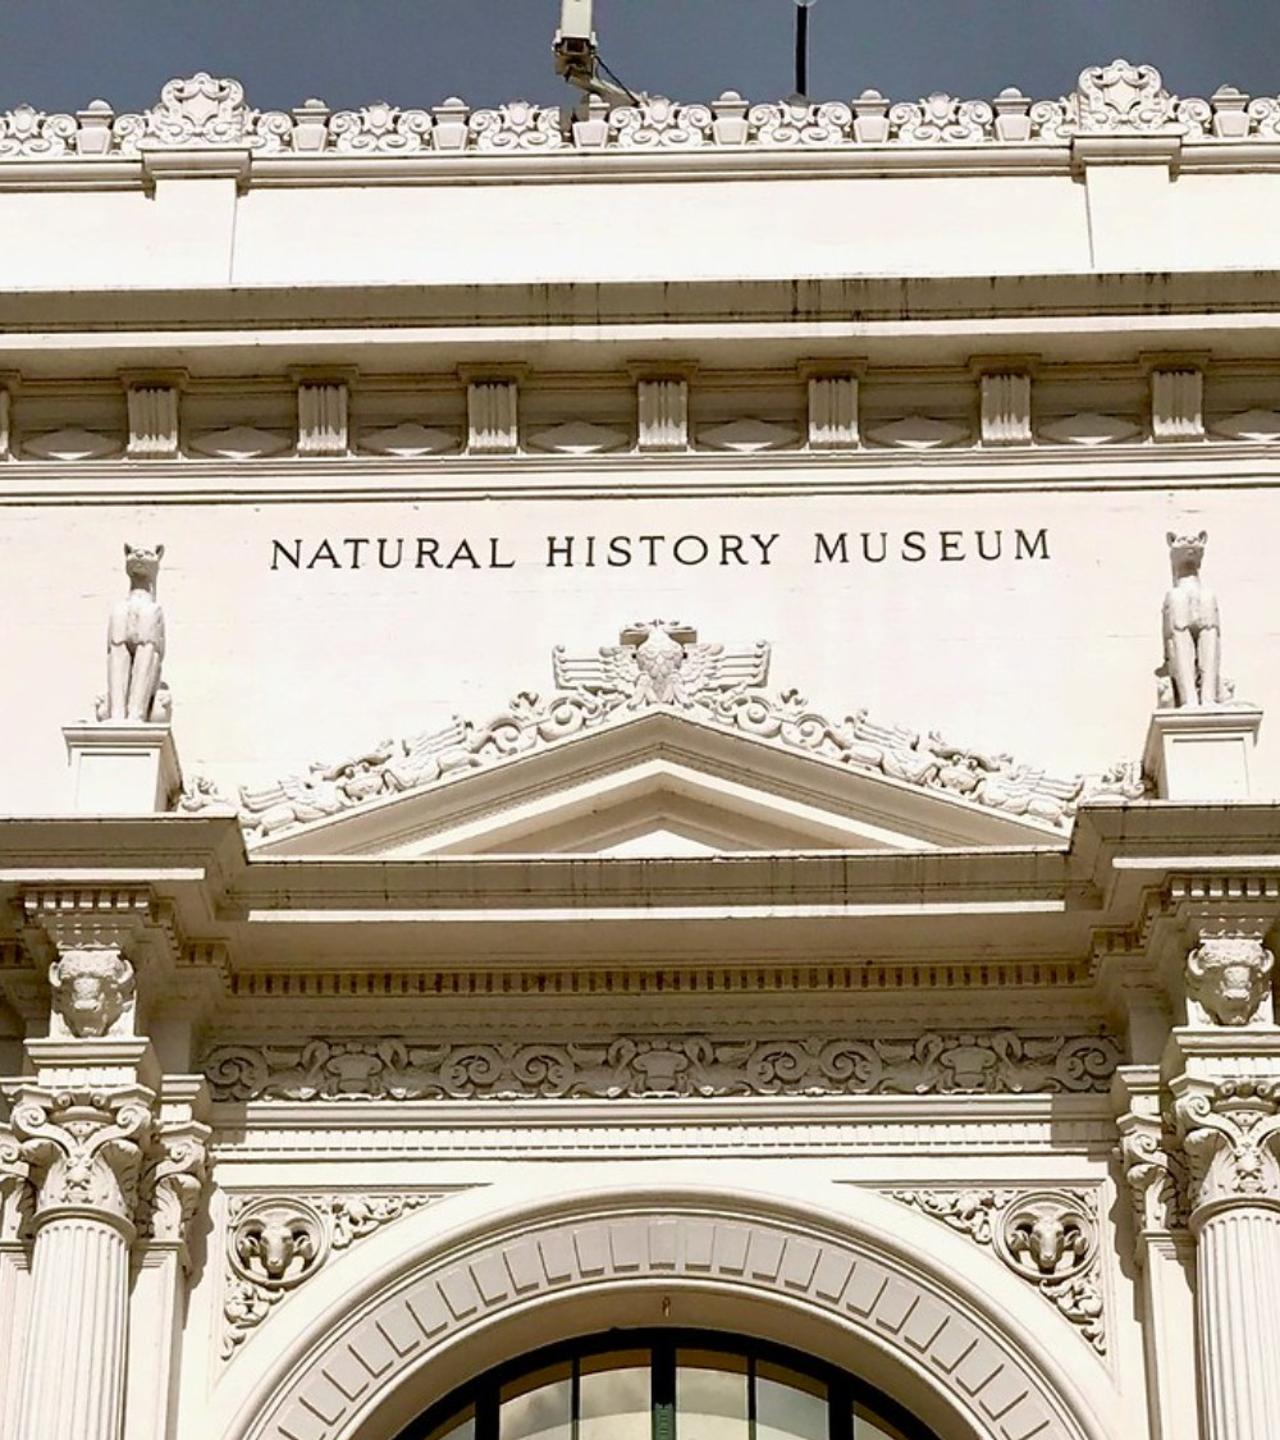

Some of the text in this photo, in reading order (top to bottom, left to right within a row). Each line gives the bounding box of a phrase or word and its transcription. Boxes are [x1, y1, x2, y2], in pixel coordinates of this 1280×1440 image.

[270, 528, 1052, 571] NATURAL HISTORY MUSEUM
